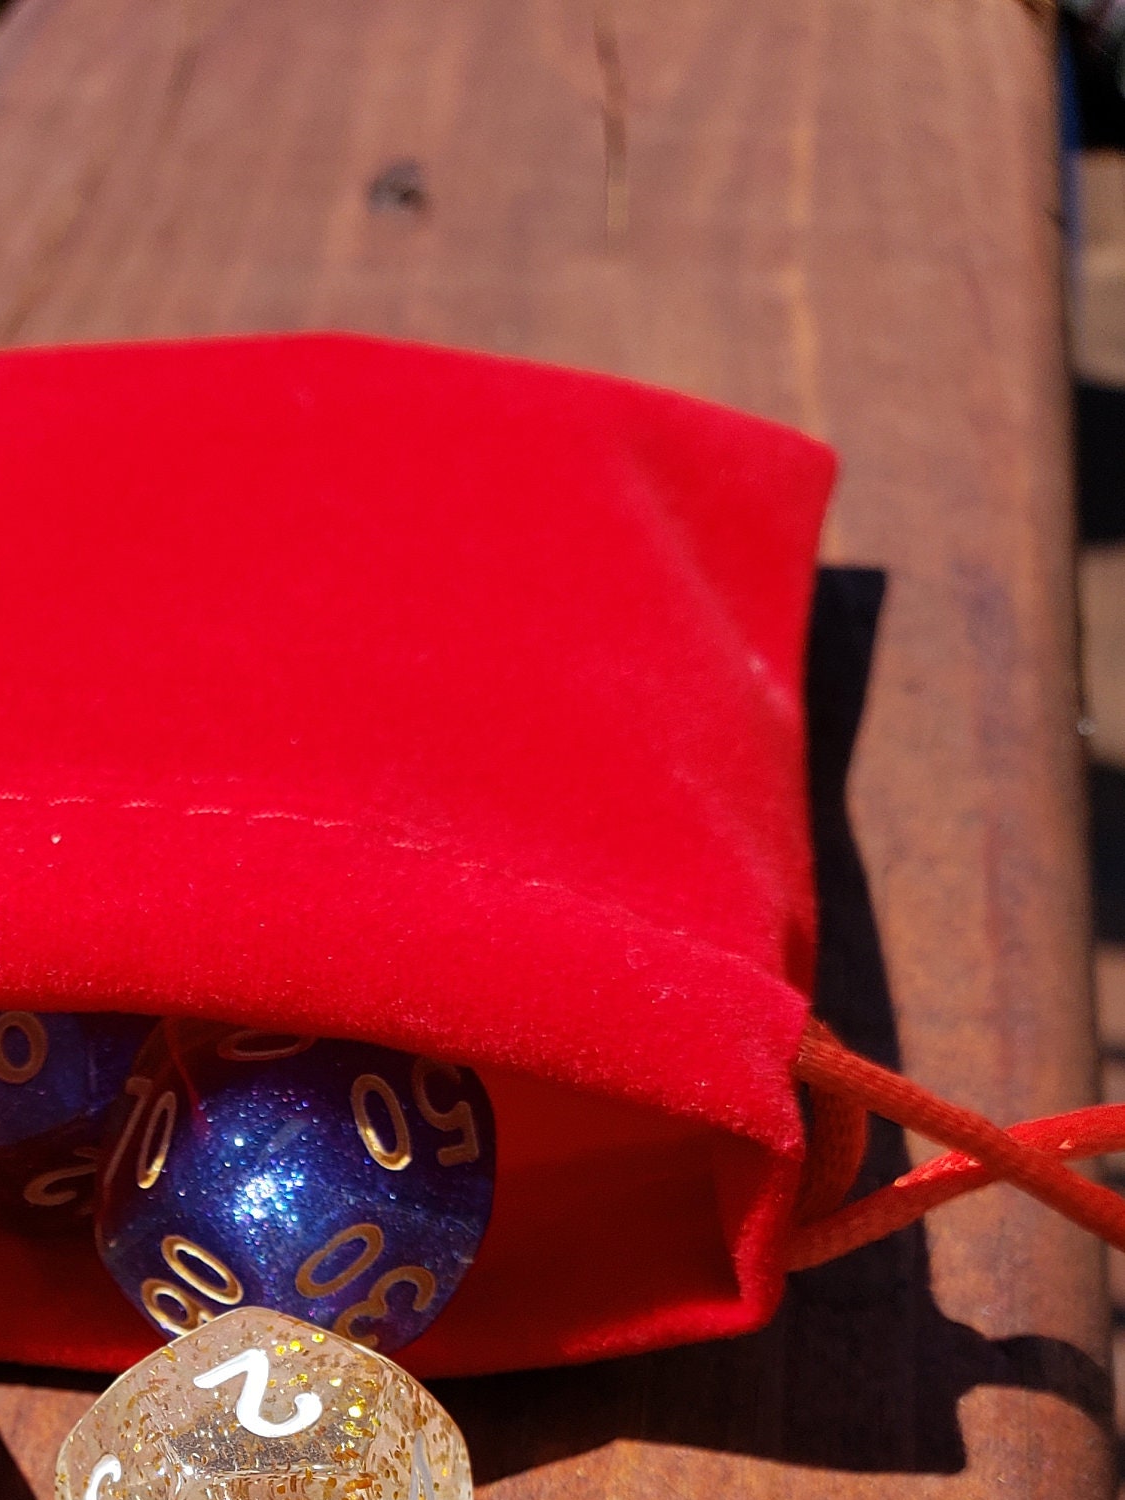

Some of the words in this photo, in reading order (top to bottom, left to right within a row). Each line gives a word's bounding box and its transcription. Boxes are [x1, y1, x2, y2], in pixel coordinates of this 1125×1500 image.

[350, 1056, 480, 1171] 50
[295, 1223, 436, 1349] 30
[193, 1348, 323, 1438] 2
